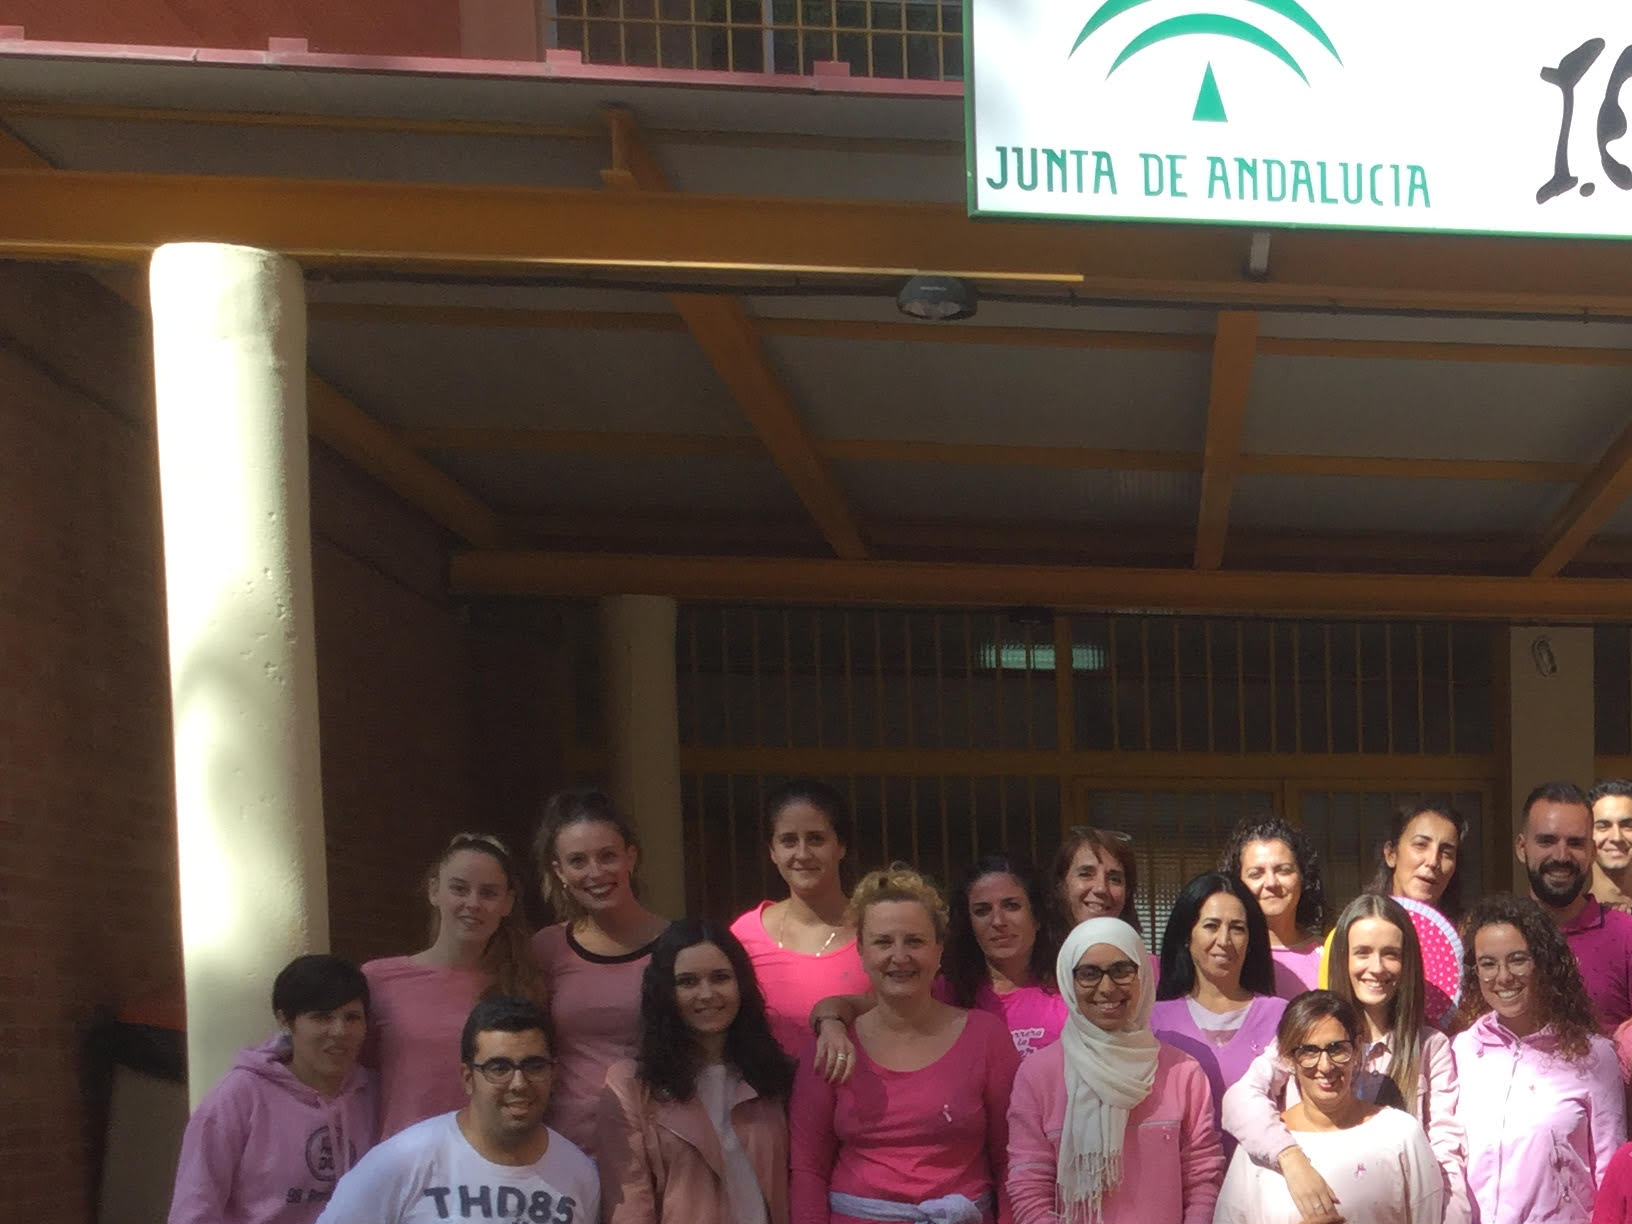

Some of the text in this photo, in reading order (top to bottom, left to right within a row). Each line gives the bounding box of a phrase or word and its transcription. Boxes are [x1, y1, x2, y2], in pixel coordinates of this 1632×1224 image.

[986, 146, 1432, 210] JUNTA DE ANDALUCIA
